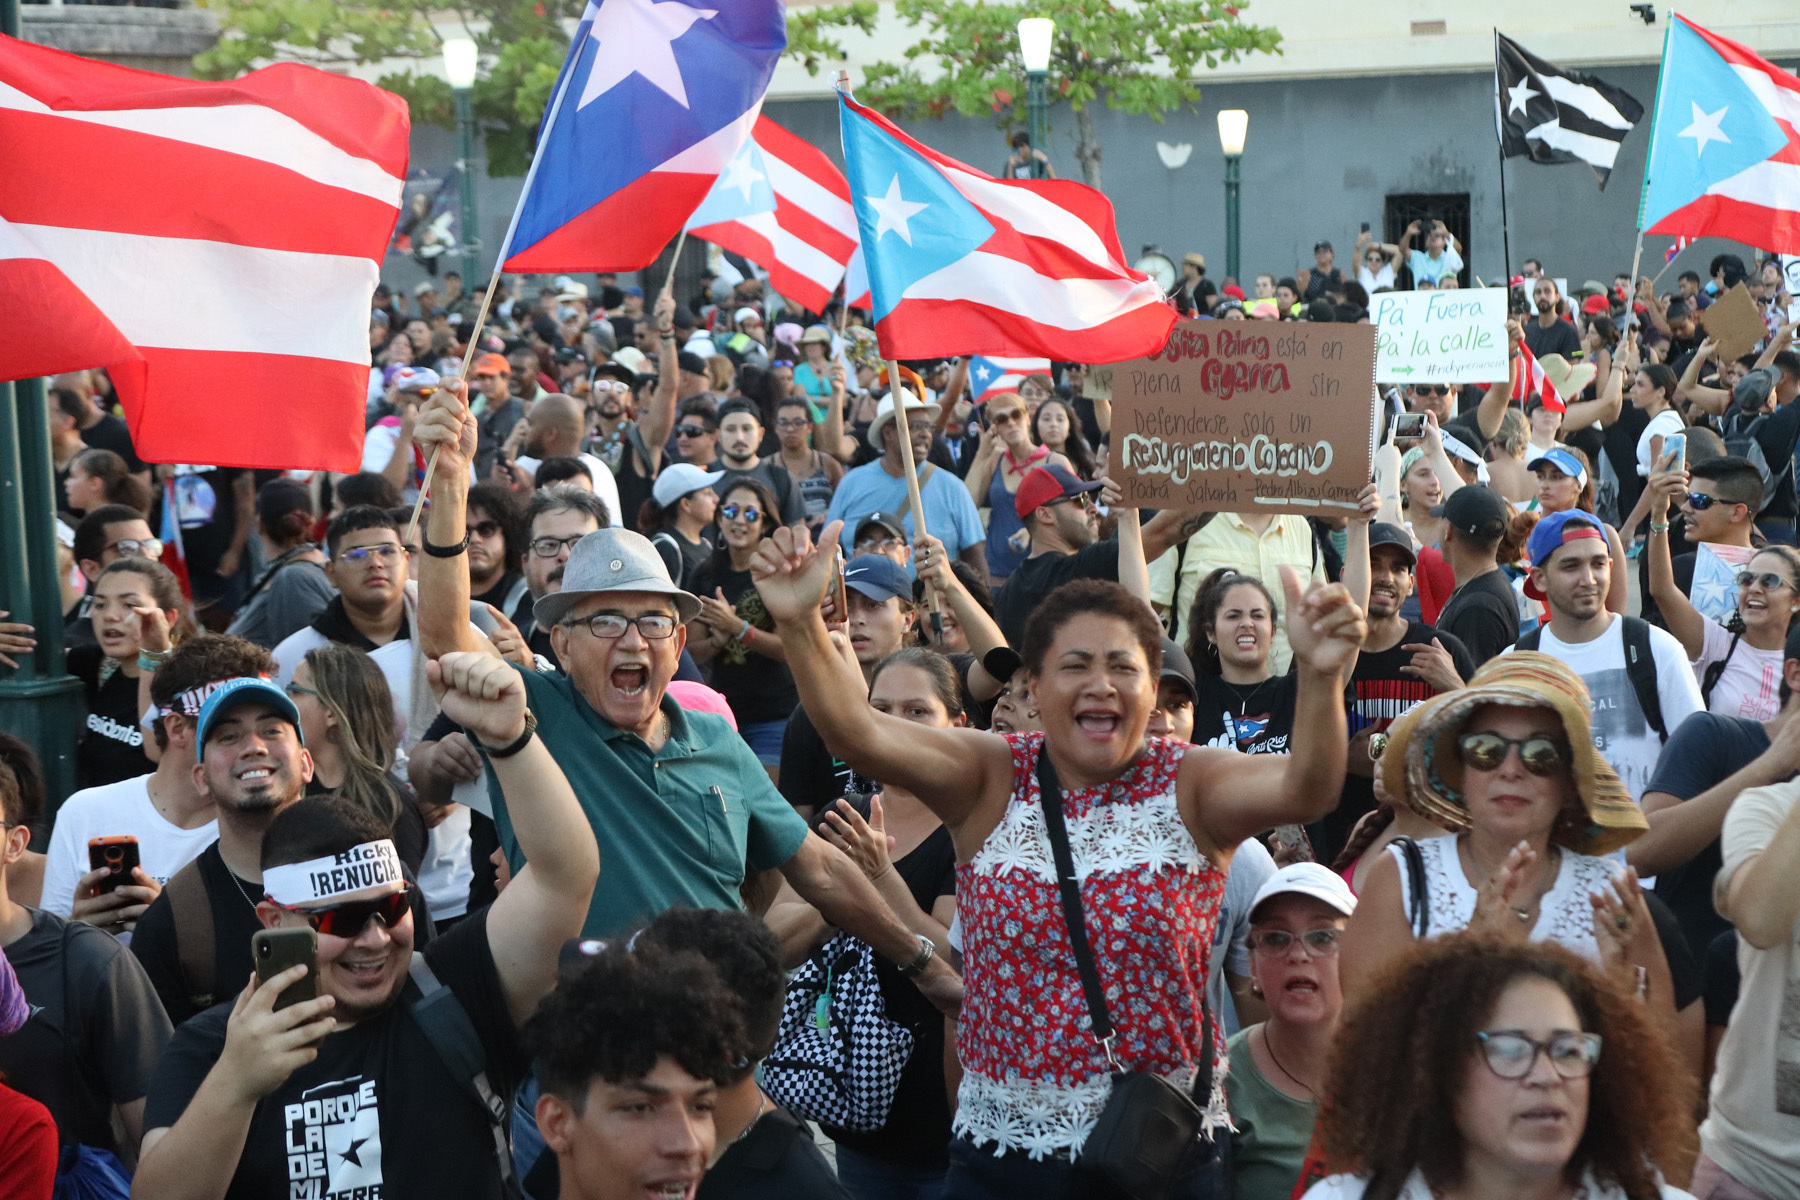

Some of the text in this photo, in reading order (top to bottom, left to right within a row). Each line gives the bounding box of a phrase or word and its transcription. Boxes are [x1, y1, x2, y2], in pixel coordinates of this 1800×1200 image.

[1425, 293, 1484, 323] Fuera
[1276, 332, 1310, 359] está
[1322, 339, 1343, 360] en
[1411, 329, 1430, 357] la
[1440, 324, 1494, 353] calle
[1133, 406, 1229, 436] Defenderse
[284, 1080, 378, 1130] PORQUE
[286, 1126, 324, 1155] LA
[287, 1151, 327, 1180] DE
